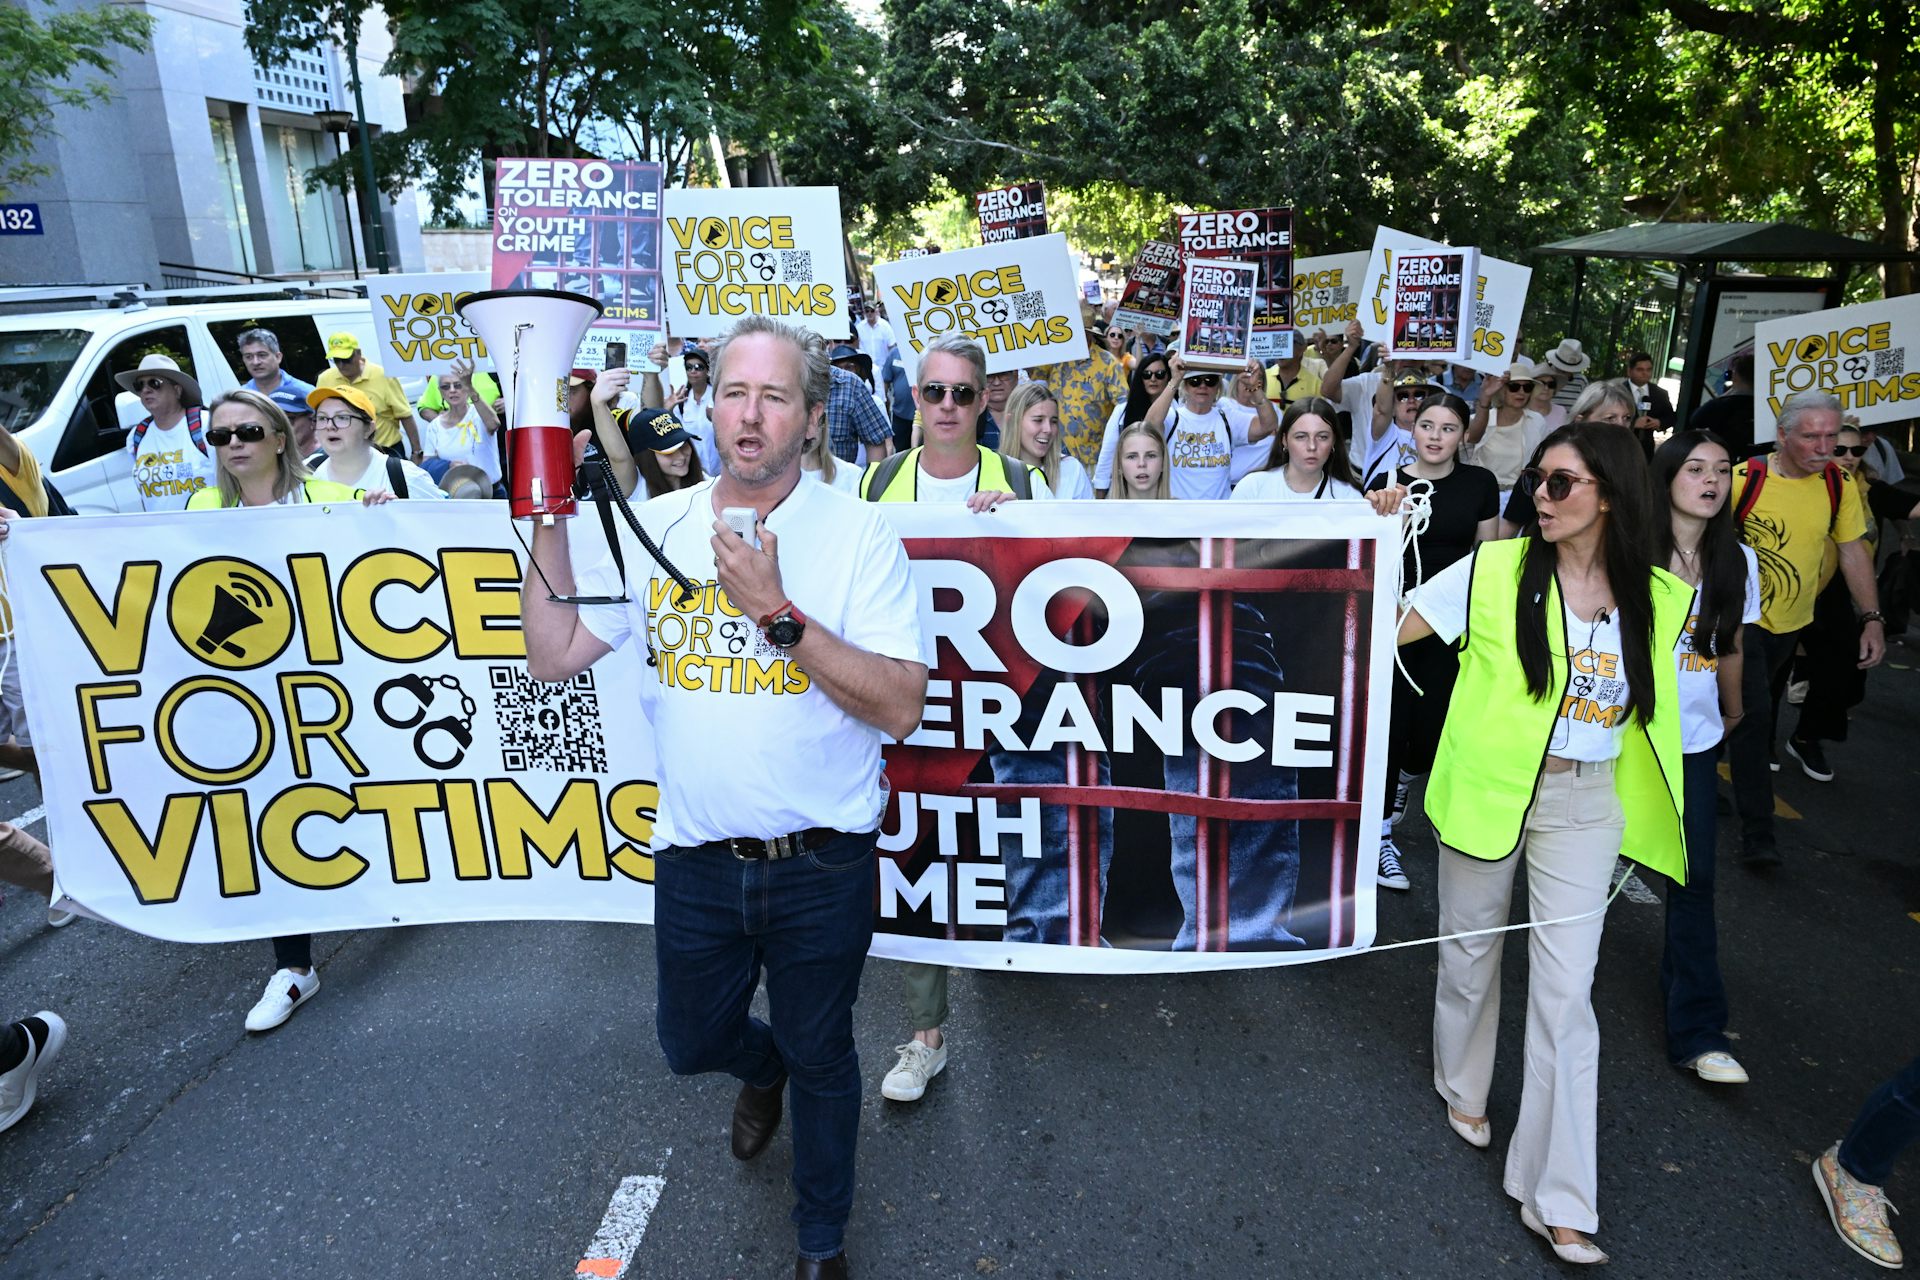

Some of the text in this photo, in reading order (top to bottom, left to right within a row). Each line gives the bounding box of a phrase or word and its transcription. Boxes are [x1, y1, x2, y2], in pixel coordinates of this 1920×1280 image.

[498, 161, 614, 189] ZERO
[498, 189, 657, 210] TOLERANCE
[977, 187, 1022, 212] ZERO
[498, 207, 518, 216] ON
[978, 202, 1043, 224] TOLERANCE
[498, 217, 586, 236] YOUTH
[667, 216, 794, 249] VOICE
[982, 226, 1016, 242] YOUTH
[1181, 212, 1259, 237] ZERO
[497, 234, 576, 252] CRIME
[1181, 231, 1290, 250] TOLERANCE
[899, 248, 928, 259] ZERO
[1141, 254, 1180, 269] TOLERA
[675, 250, 748, 282] FOR
[1136, 266, 1168, 279] YOUTH
[1193, 267, 1235, 285] ZERO
[1399, 258, 1444, 275] ZERO
[892, 265, 1025, 311] VOICE
[1132, 274, 1161, 285] CRIME
[1192, 283, 1250, 297] TOLERANCE
[1293, 269, 1343, 291] OICE
[1398, 274, 1460, 286] TOLERANCE
[382, 292, 476, 317] VOI
[676, 284, 836, 316] VICTIMS
[1191, 298, 1223, 309] YOUTH
[1293, 291, 1312, 310] OR
[1396, 302, 1426, 312] CRIME
[1398, 292, 1431, 302] YOUTH
[602, 307, 648, 318] CTIMS
[904, 303, 980, 338] FOR
[1190, 308, 1218, 319] CRIME
[1252, 316, 1285, 324] CTIMS
[1294, 303, 1358, 327] CTIMS
[389, 316, 458, 340] FOR
[910, 316, 1072, 354] TIMS
[390, 337, 487, 362] VICTI
[1767, 322, 1891, 368] VOICE
[1770, 360, 1839, 396] FOR
[1767, 372, 1920, 418] TIMS
[1177, 430, 1216, 445] VOICE
[1172, 453, 1230, 468] VICTIMS
[1174, 442, 1200, 458] FOR
[42, 546, 526, 675] VOICE
[909, 557, 1144, 674] RO
[647, 612, 713, 653] FOR
[1568, 646, 1619, 678] ICE
[76, 671, 370, 794] FOR
[881, 678, 1335, 768] ERANCE
[876, 792, 1042, 858] UTH
[84, 778, 657, 905] VICTIMS
